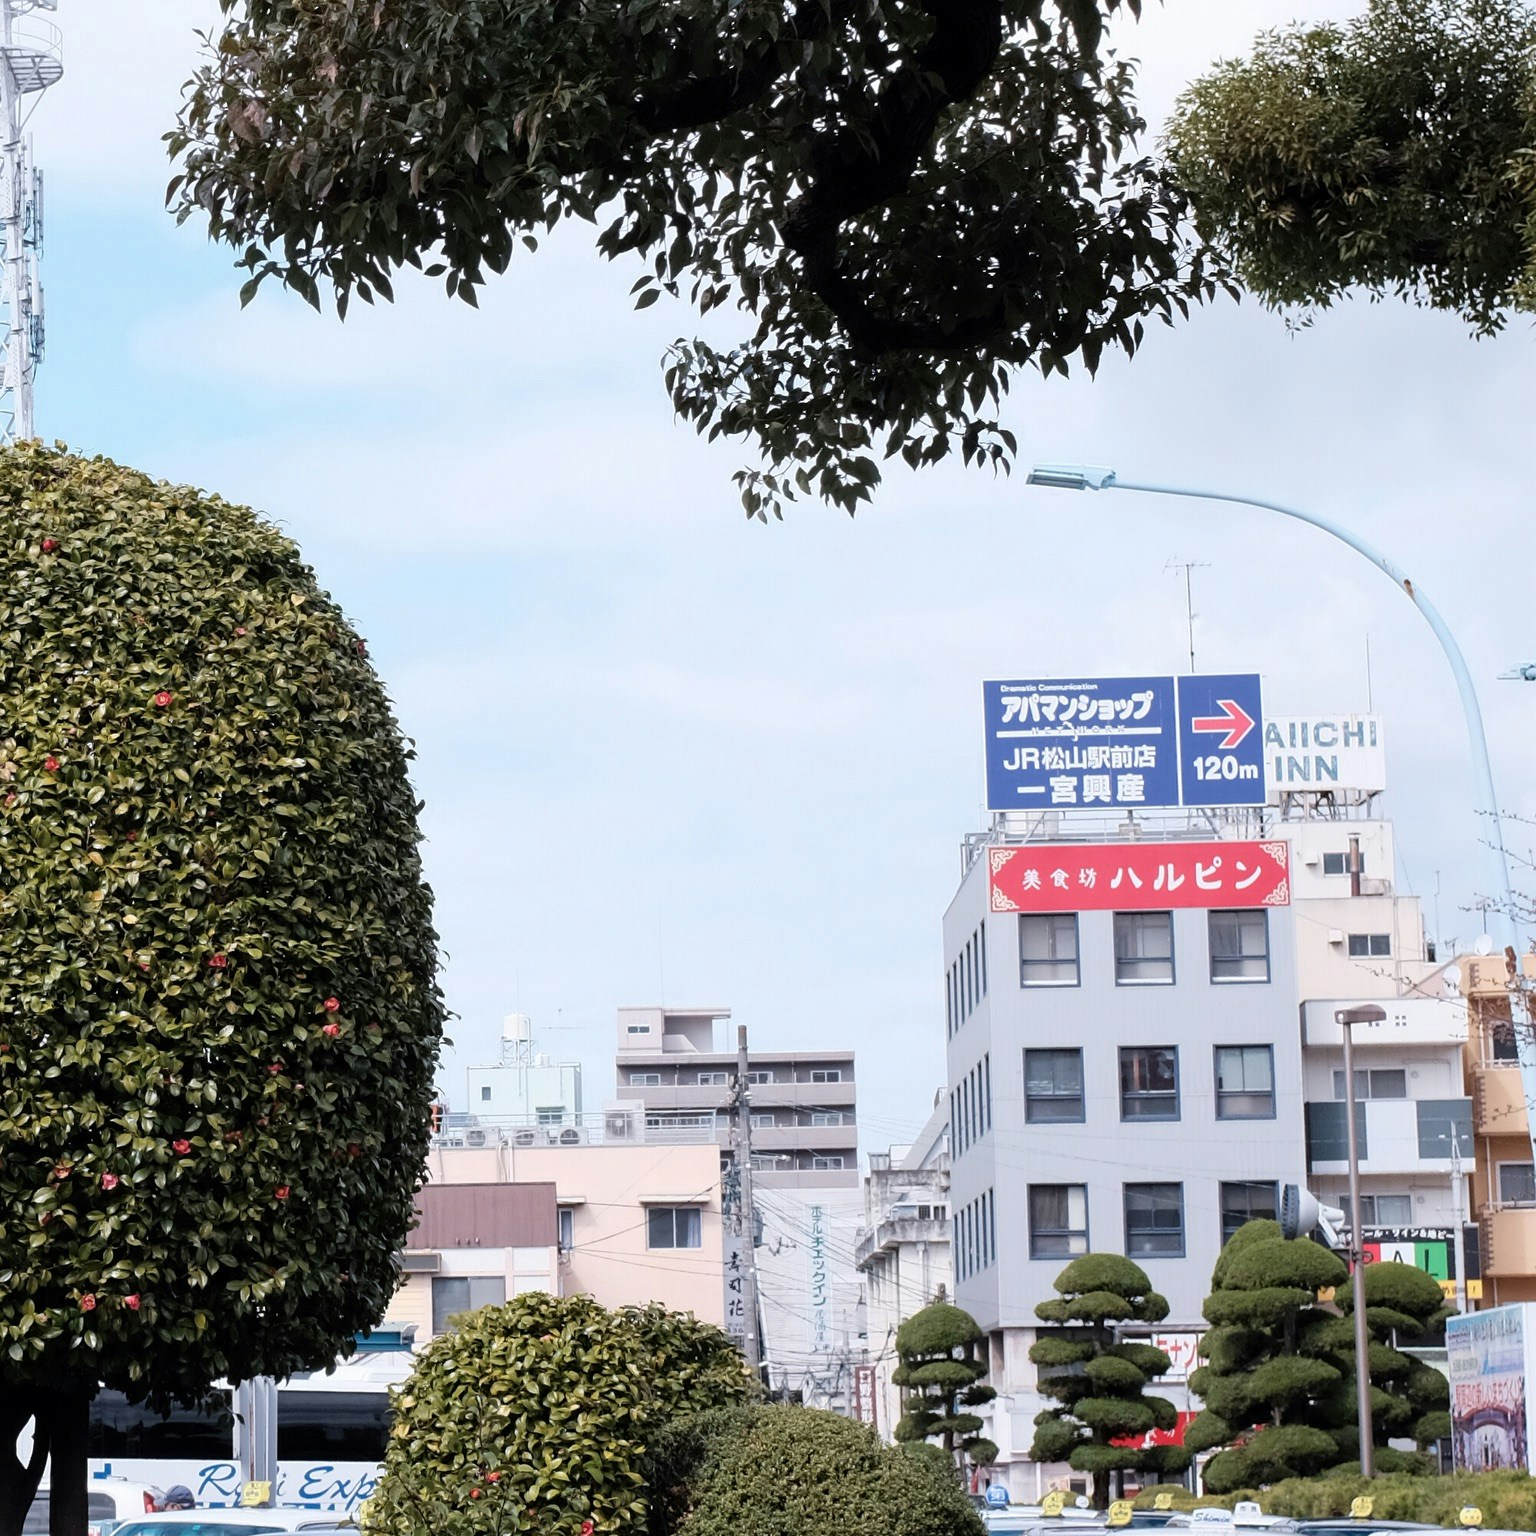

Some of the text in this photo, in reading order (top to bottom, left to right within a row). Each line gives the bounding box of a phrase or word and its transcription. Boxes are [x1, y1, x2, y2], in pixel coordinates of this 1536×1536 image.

[1000, 683, 1099, 693] Dramatic Communication
[1000, 690, 1154, 723] アパマンショップ
[1003, 744, 1157, 771] JR松山駅前店
[1193, 755, 1259, 781] 120m
[1275, 755, 1338, 783] INN
[1016, 773, 1146, 804] 一宮興産
[1022, 855, 1262, 892] 美食坊 ハルピン
[1193, 1511, 1231, 1524] Shimin
